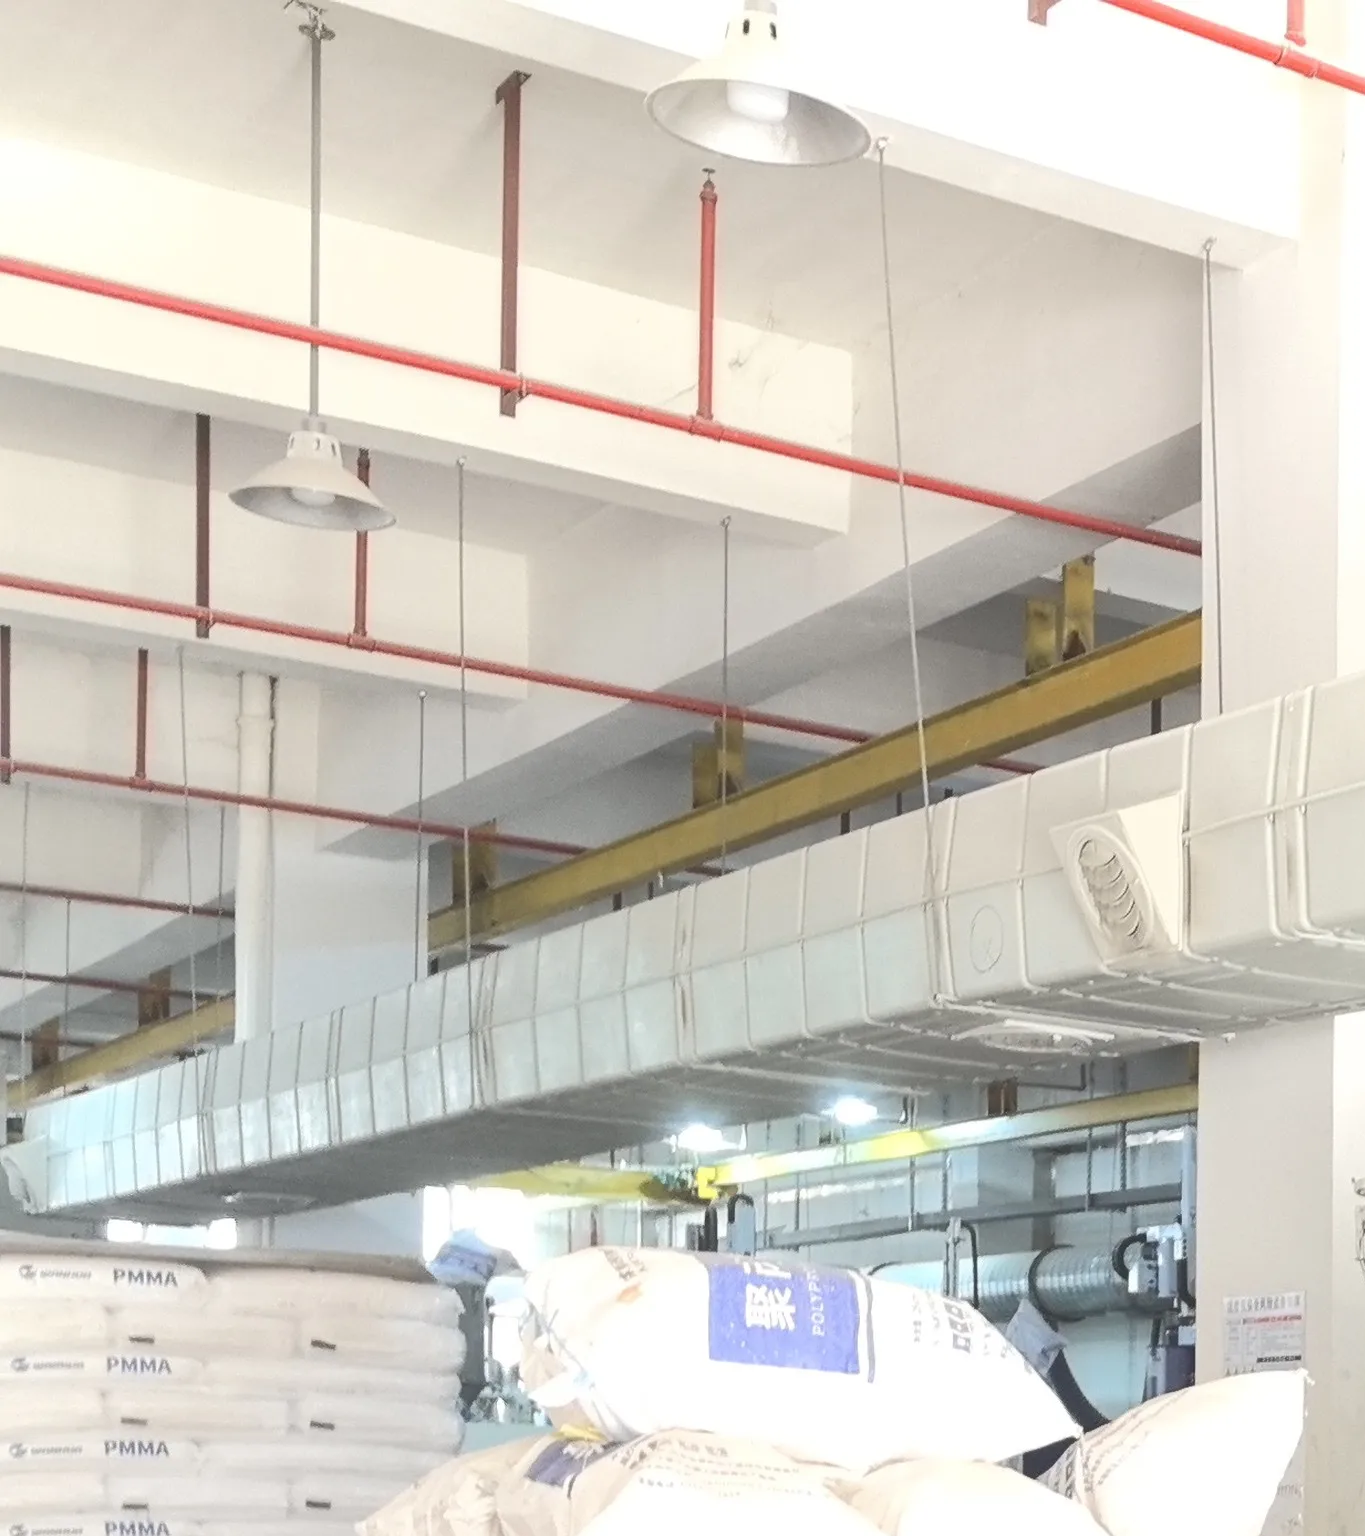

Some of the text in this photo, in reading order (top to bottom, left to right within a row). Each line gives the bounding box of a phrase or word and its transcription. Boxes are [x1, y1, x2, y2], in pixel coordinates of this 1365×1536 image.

[113, 1267, 178, 1287] PMMA
[106, 1356, 172, 1375] PMMA
[104, 1440, 170, 1458] PMMA
